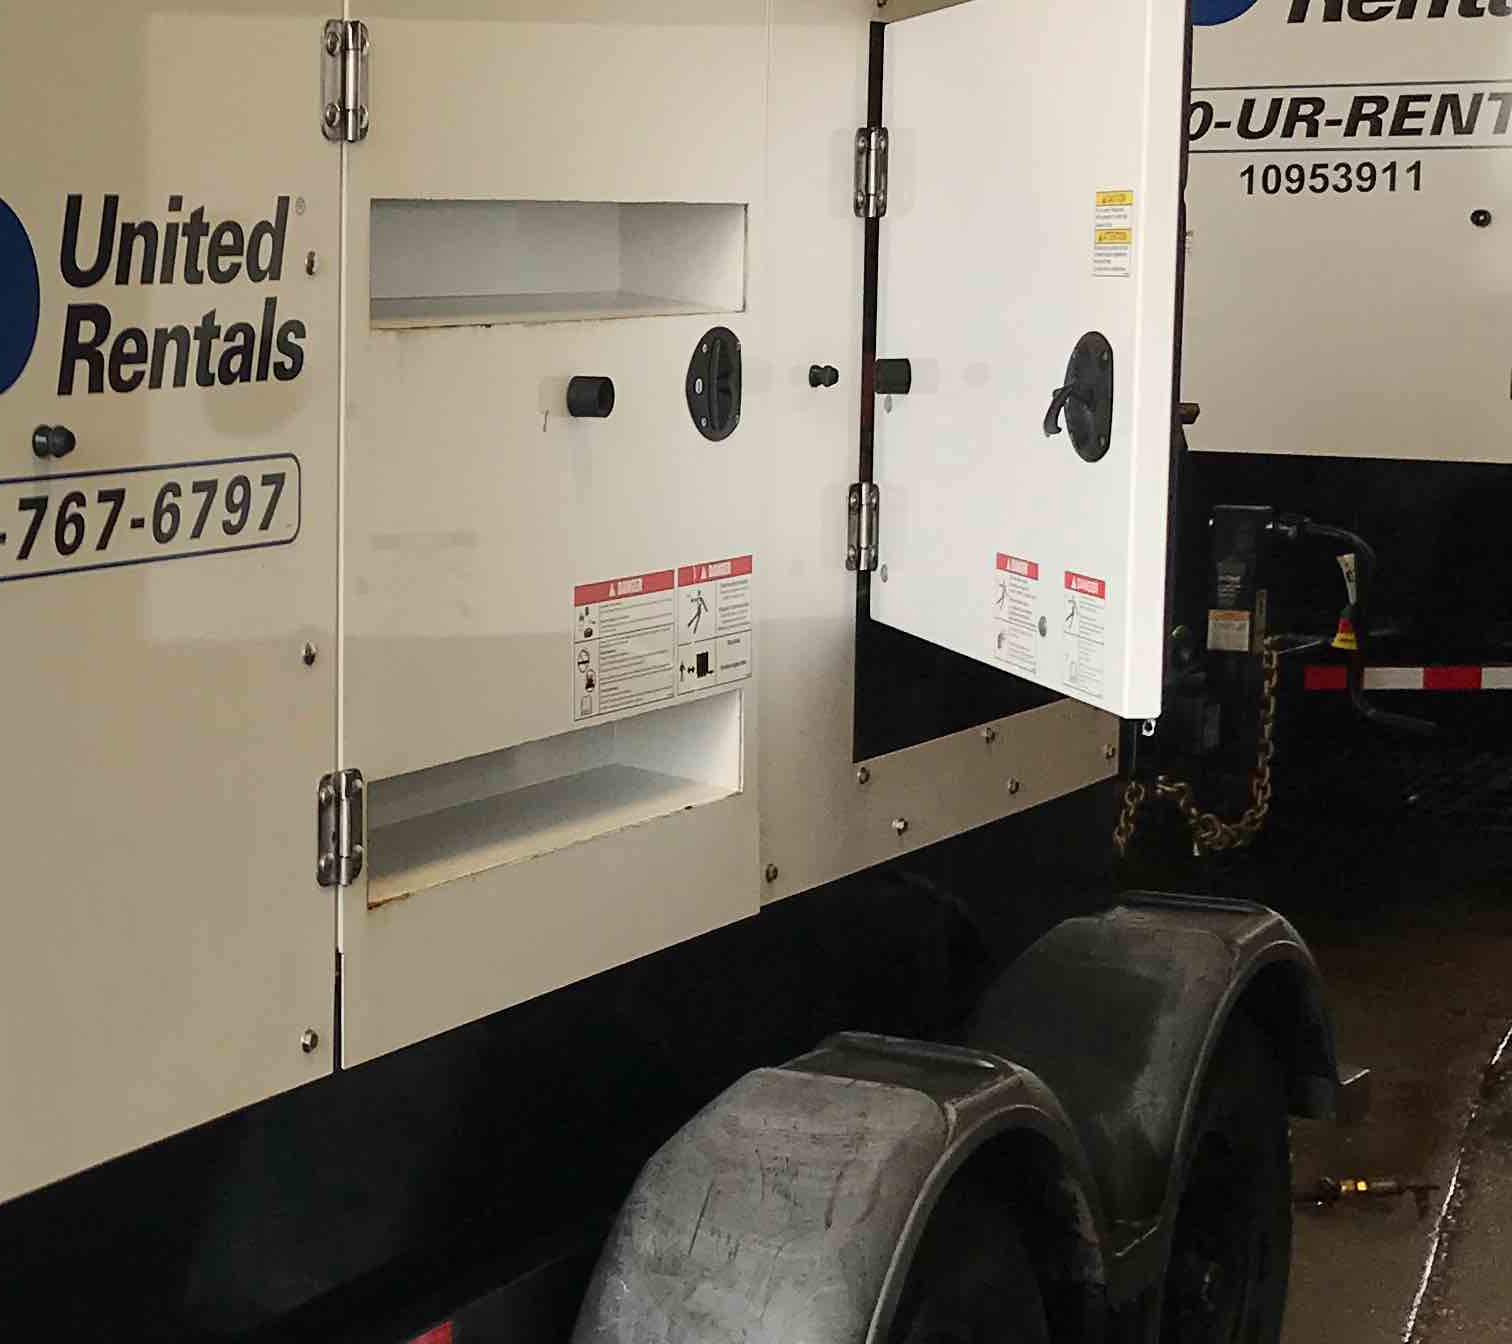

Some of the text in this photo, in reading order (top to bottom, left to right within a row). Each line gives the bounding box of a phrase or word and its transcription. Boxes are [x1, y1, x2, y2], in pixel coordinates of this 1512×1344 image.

[1239, 160, 1422, 195] 10953911
[59, 193, 290, 288] United
[56, 296, 307, 396] Rentals
